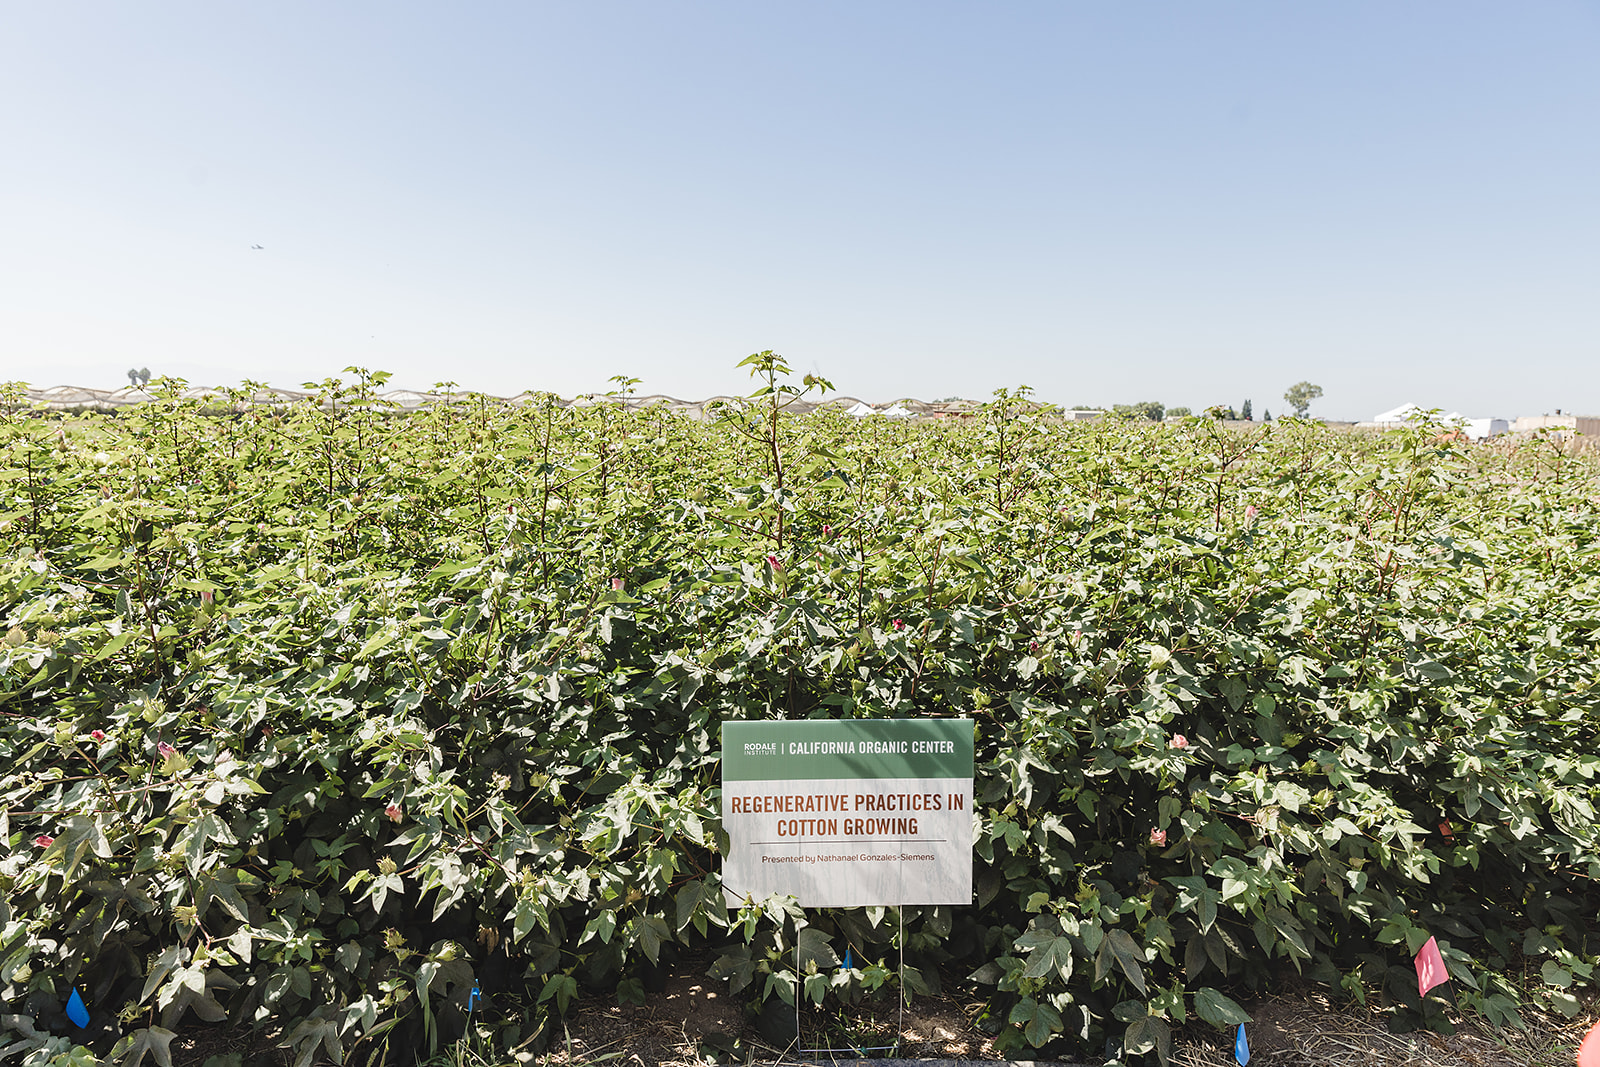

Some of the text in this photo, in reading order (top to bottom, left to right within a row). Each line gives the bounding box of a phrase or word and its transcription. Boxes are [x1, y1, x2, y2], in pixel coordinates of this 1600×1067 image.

[744, 742, 777, 750] RODALE
[789, 741, 954, 755] CALIFORNIA ORGANIC CENTER
[731, 793, 964, 814] REGENERATIVE PRACTICES IN
[777, 817, 918, 837] COTTON GROWING
[761, 853, 935, 865] Presented by Nathanael Gonzales-Siemens
